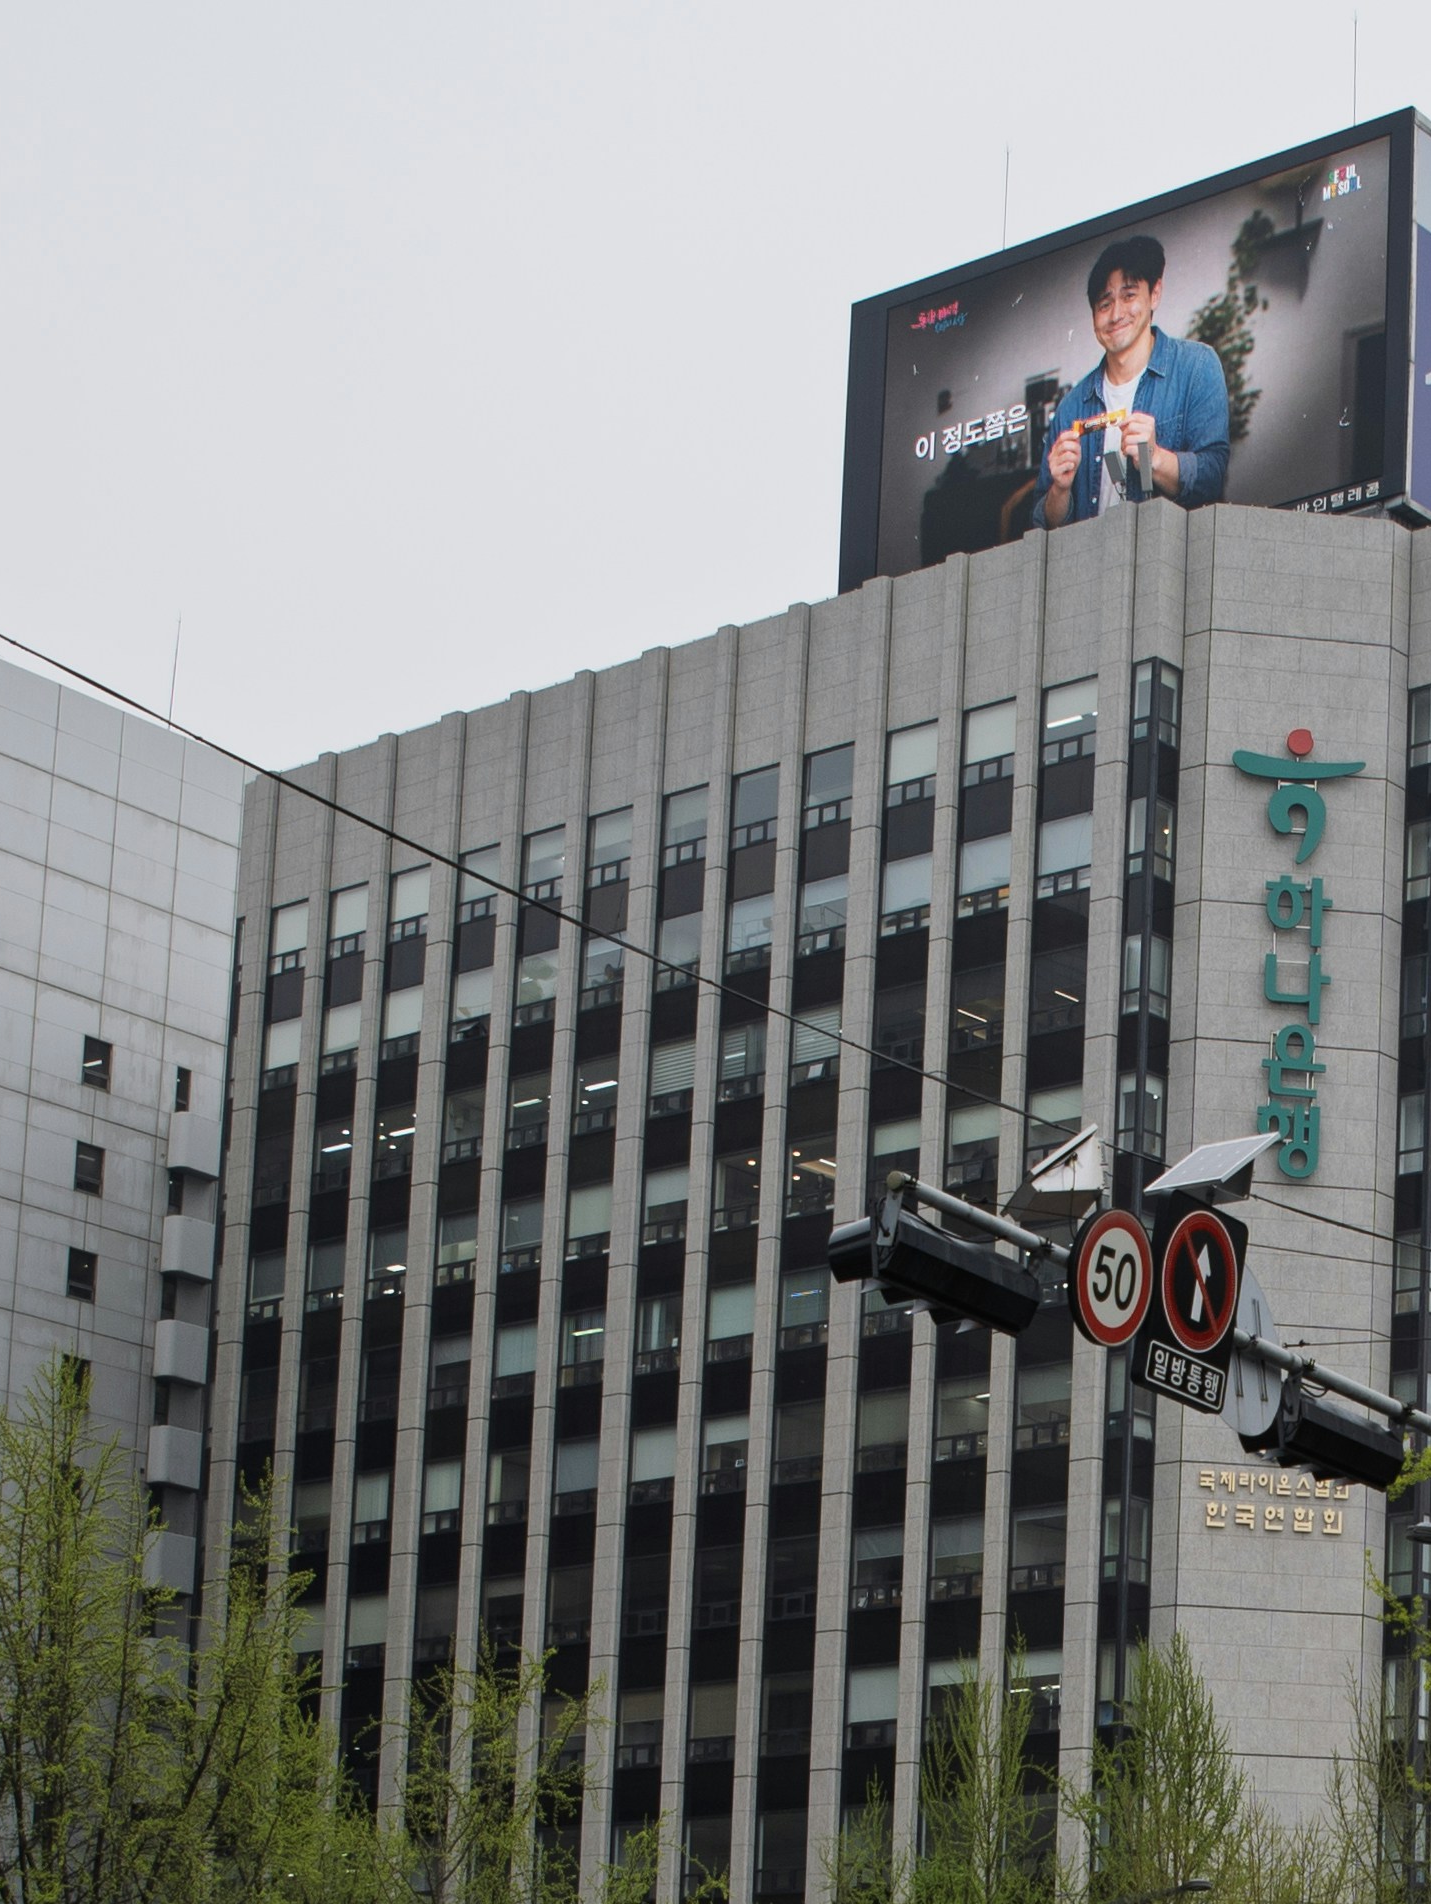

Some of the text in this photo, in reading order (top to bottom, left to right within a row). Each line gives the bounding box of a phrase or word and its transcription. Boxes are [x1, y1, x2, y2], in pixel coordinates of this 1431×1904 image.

[915, 431, 936, 461] 이
[1257, 875, 1333, 1178] 하나은행
[1092, 1244, 1137, 1312] 50
[1153, 1349, 1220, 1403] 일방통행
[1205, 1501, 1344, 1535] 한국연합회
